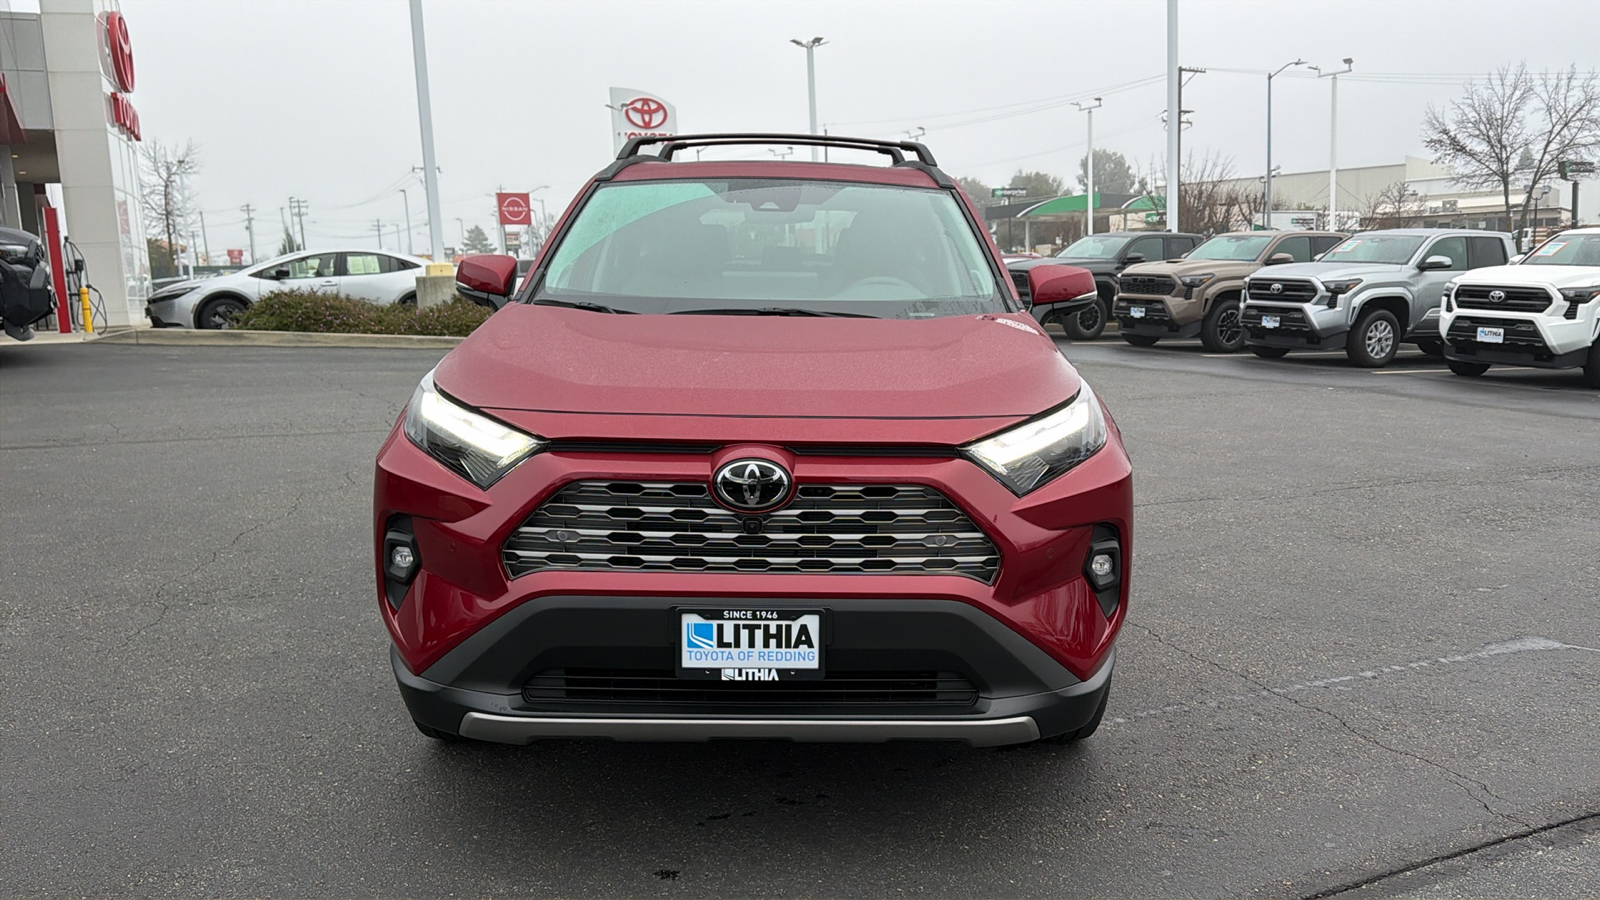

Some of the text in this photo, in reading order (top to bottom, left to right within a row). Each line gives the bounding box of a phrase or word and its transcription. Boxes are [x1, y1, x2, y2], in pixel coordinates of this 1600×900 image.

[723, 610, 778, 619] SINCE 1946
[716, 623, 815, 649] LITHIA
[687, 650, 816, 662] TOYOTA OF REDDING
[734, 668, 779, 681] LITHIA
